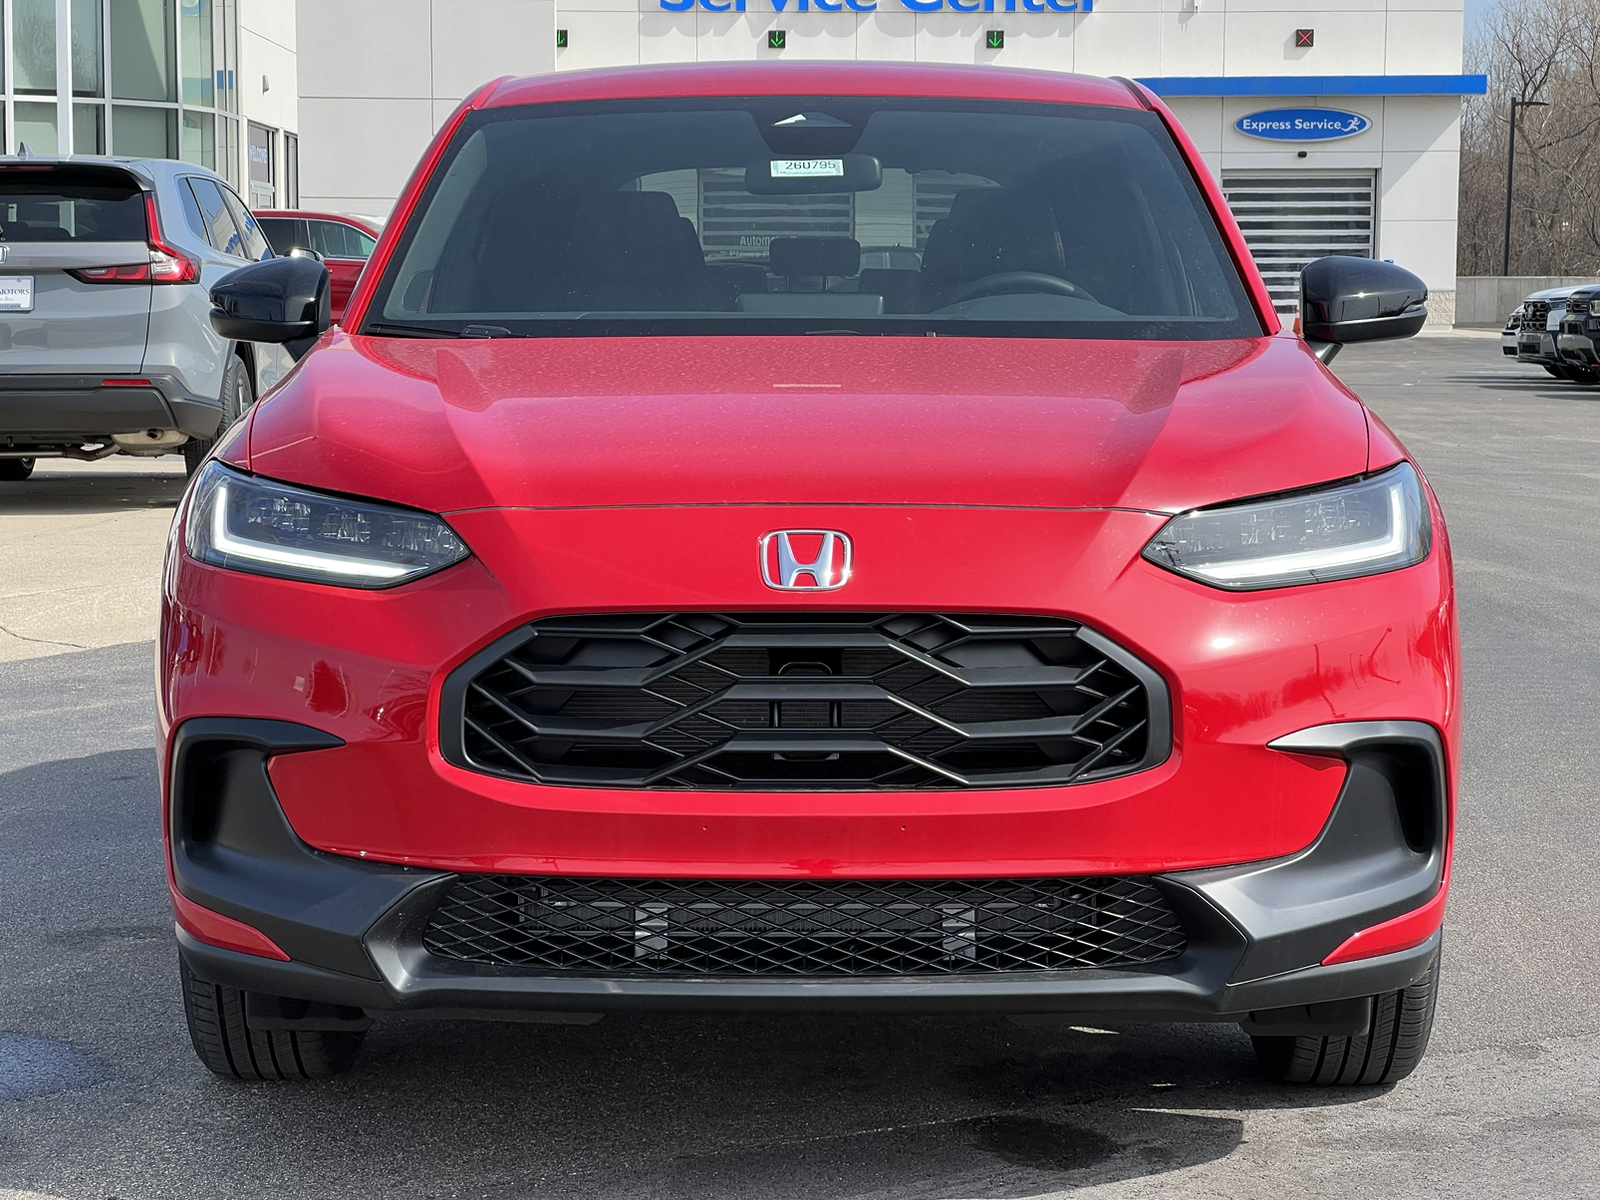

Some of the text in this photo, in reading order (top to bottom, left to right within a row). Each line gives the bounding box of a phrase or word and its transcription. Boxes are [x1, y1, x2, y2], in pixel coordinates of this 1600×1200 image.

[1243, 119, 1341, 132] Express Service
[785, 161, 836, 170] 260795
